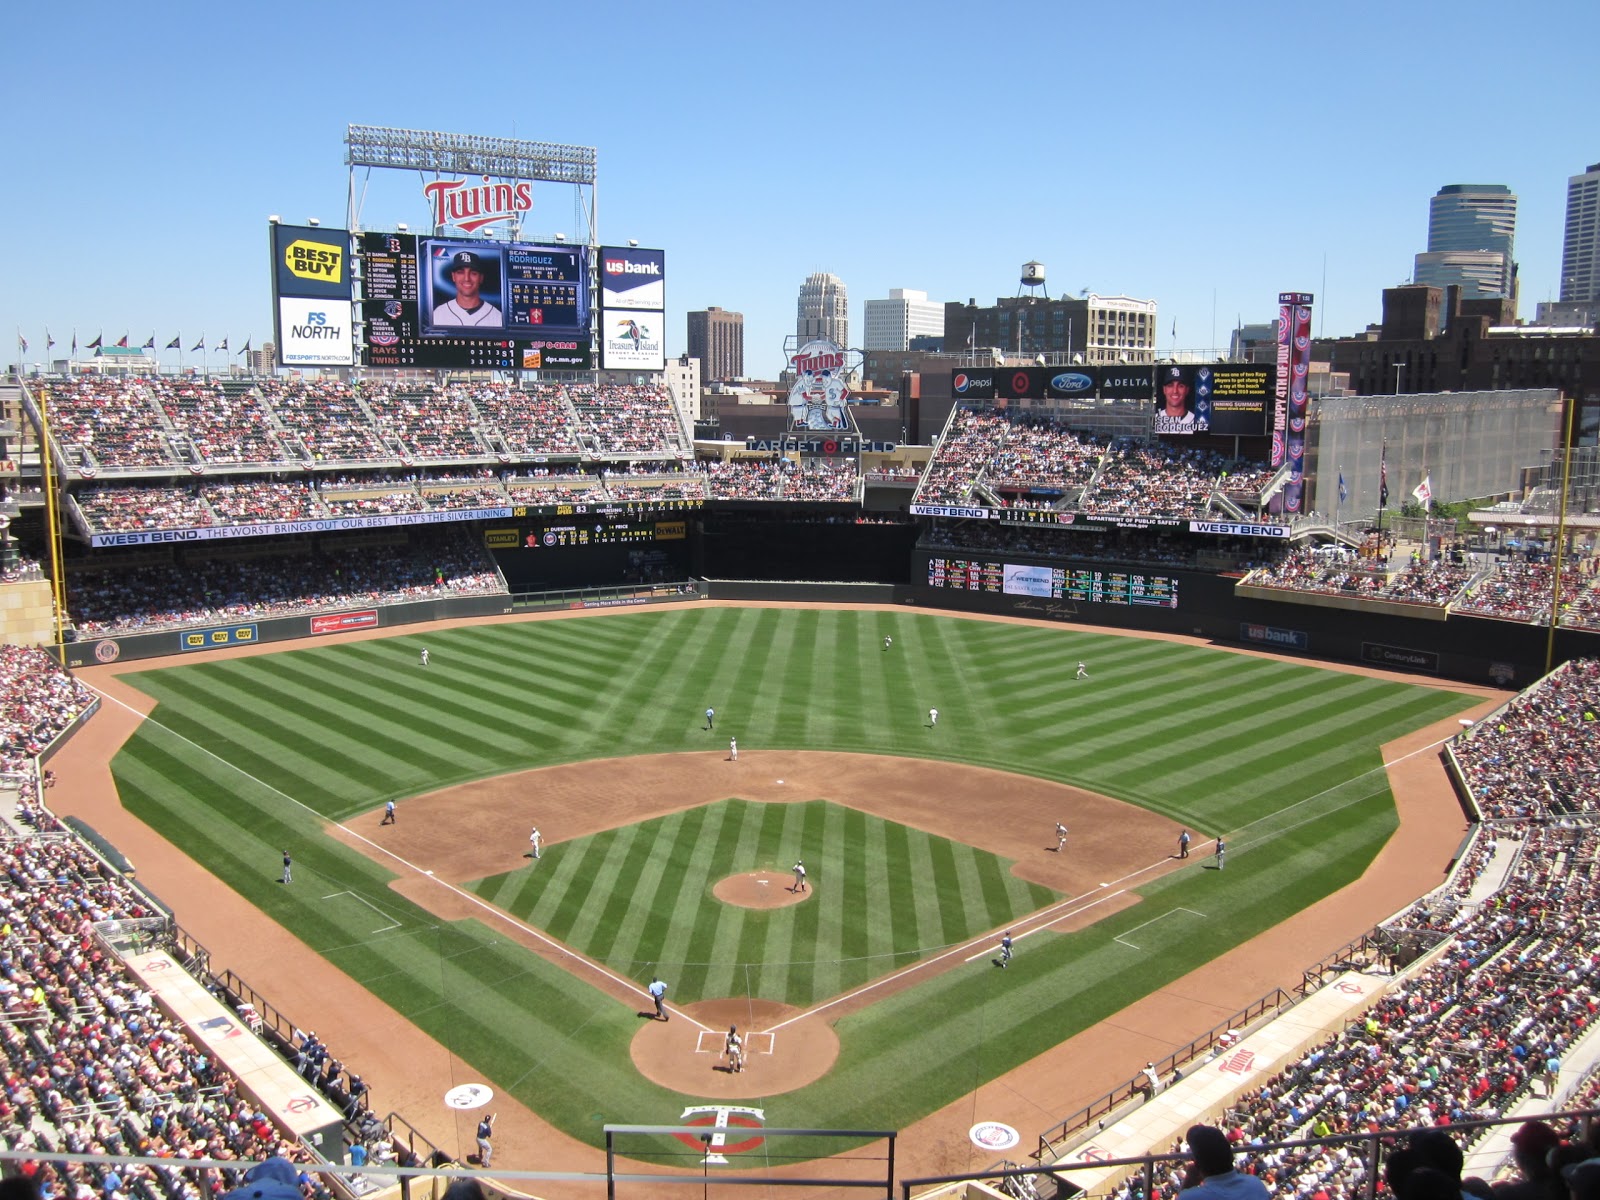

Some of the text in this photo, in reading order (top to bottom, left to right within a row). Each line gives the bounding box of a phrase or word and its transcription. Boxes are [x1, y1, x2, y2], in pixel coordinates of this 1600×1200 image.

[424, 174, 533, 229] Twins
[293, 246, 340, 264] BEST
[509, 256, 552, 264] RODRIGUEZ
[570, 255, 575, 266] 1
[294, 259, 336, 276] BUY
[606, 260, 661, 274] usbank
[1028, 266, 1036, 277] 3
[307, 312, 326, 326] FS
[292, 325, 340, 340] NORTH
[608, 340, 658, 350] Treasure Island
[790, 351, 844, 377] Twins
[970, 378, 991, 389] pepsi
[1058, 376, 1083, 390] Ford
[1274, 344, 1289, 430] HAPPY 4TH OF JULY
[1156, 423, 1208, 432] RODRIGUEZ
[746, 440, 896, 452] TARGET FIELD
[0, 461, 14, 471] 14
[916, 506, 983, 518] WEST BEND
[100, 533, 148, 546] WEST
[206, 529, 228, 538] THE
[231, 525, 270, 536] WORST
[275, 522, 312, 533] BRINGS
[316, 521, 338, 530] OUT
[342, 519, 363, 529] OUR
[367, 517, 390, 526] BEST.
[394, 514, 426, 524] THAT'S
[428, 513, 444, 522] THE
[447, 511, 474, 521] SILVER
[1197, 523, 1284, 536] WEST BEND
[1248, 626, 1297, 644] usbank
[1384, 650, 1427, 664] CenturyLink
